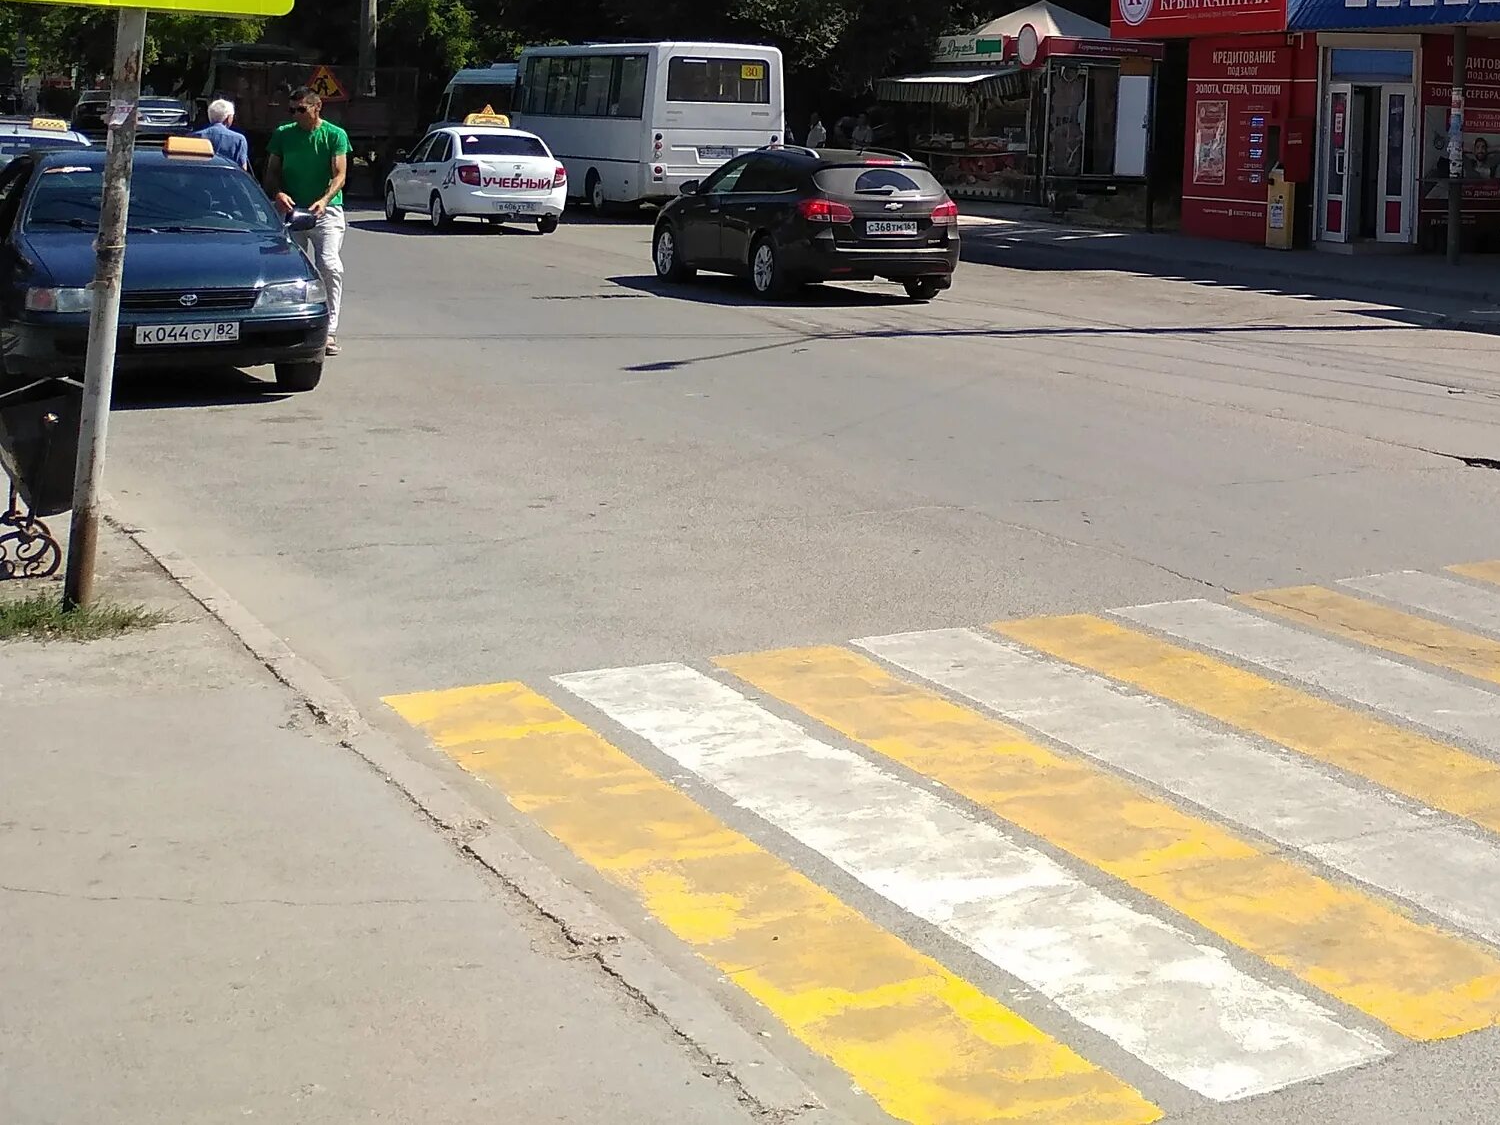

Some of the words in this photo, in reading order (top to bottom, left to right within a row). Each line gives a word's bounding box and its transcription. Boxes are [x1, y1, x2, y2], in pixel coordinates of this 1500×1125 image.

[1212, 50, 1277, 65] КРЕДИТОВАНИЕ
[745, 66, 758, 77] 30
[1227, 66, 1240, 76] ПОД
[1240, 66, 1259, 76] ЗАЛОГ
[1467, 71, 1482, 81] ПОД
[1195, 83, 1220, 94] ЗОЛОТА,
[1222, 83, 1250, 95] СЕРЕБРА,
[1252, 84, 1281, 95] ТЕХНИКИ
[483, 176, 551, 189] УЧЕБНЫЙ
[868, 222, 904, 232] С368ТМ
[143, 326, 212, 342] К044СУ
[216, 323, 234, 335] 82
